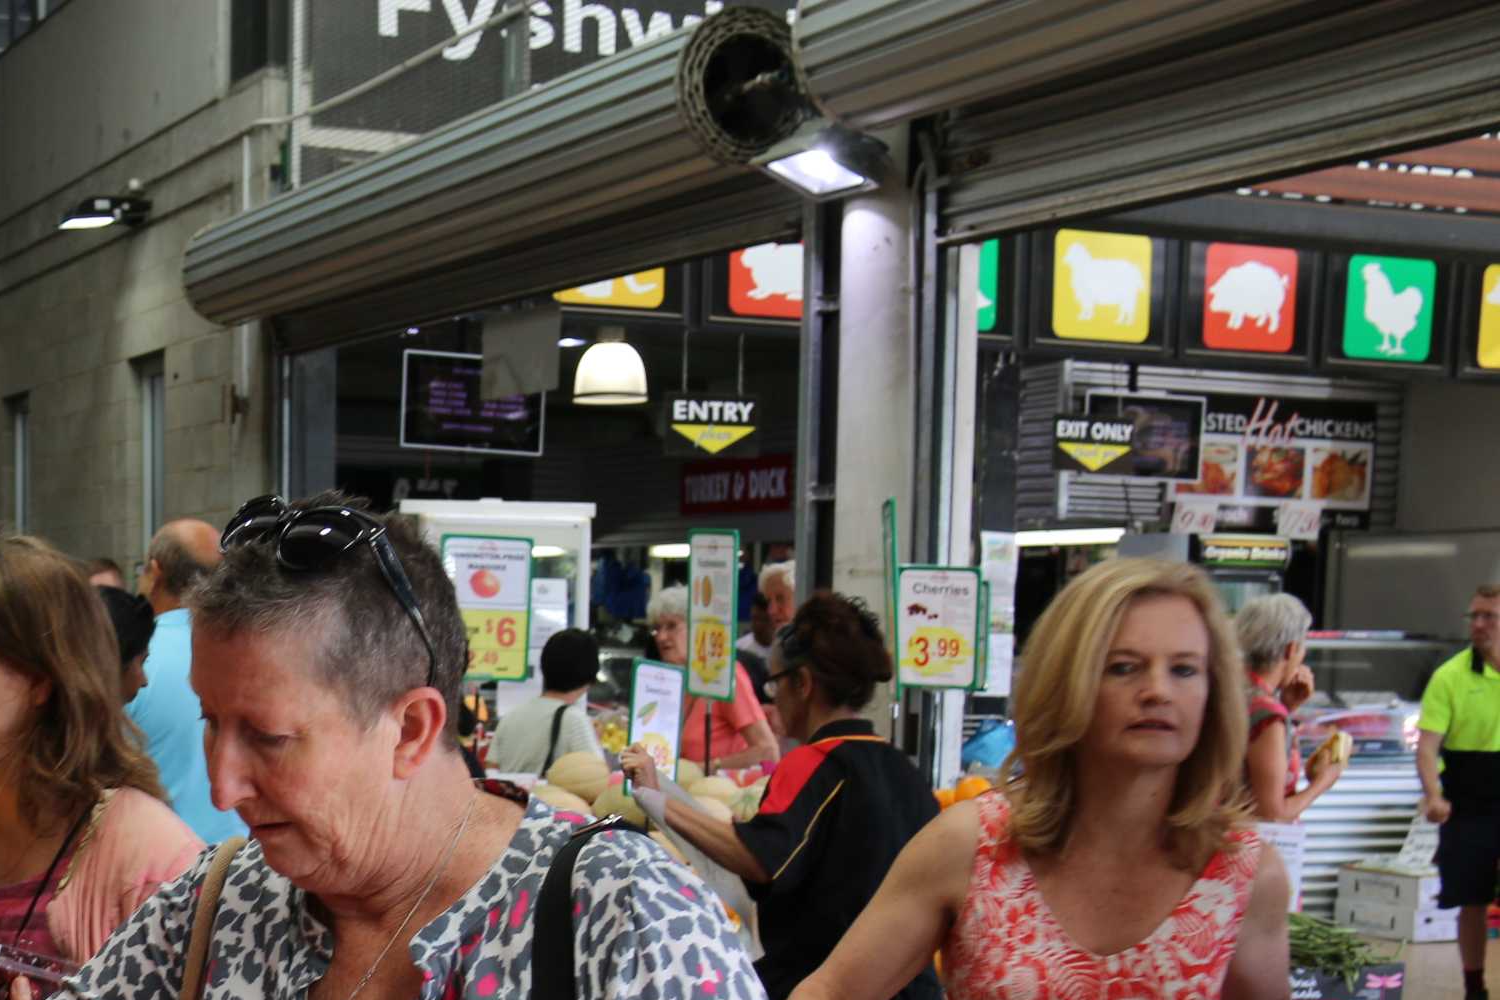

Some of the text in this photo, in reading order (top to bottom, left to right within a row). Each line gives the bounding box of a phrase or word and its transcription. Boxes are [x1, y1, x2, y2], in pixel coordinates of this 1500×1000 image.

[672, 399, 755, 423] ENTRY
[1055, 419, 1134, 442] EXIT ONLY
[1295, 417, 1376, 440] CHICKENS
[733, 471, 746, 500] &
[748, 466, 787, 499] DUCK
[911, 582, 970, 597] Cherries
